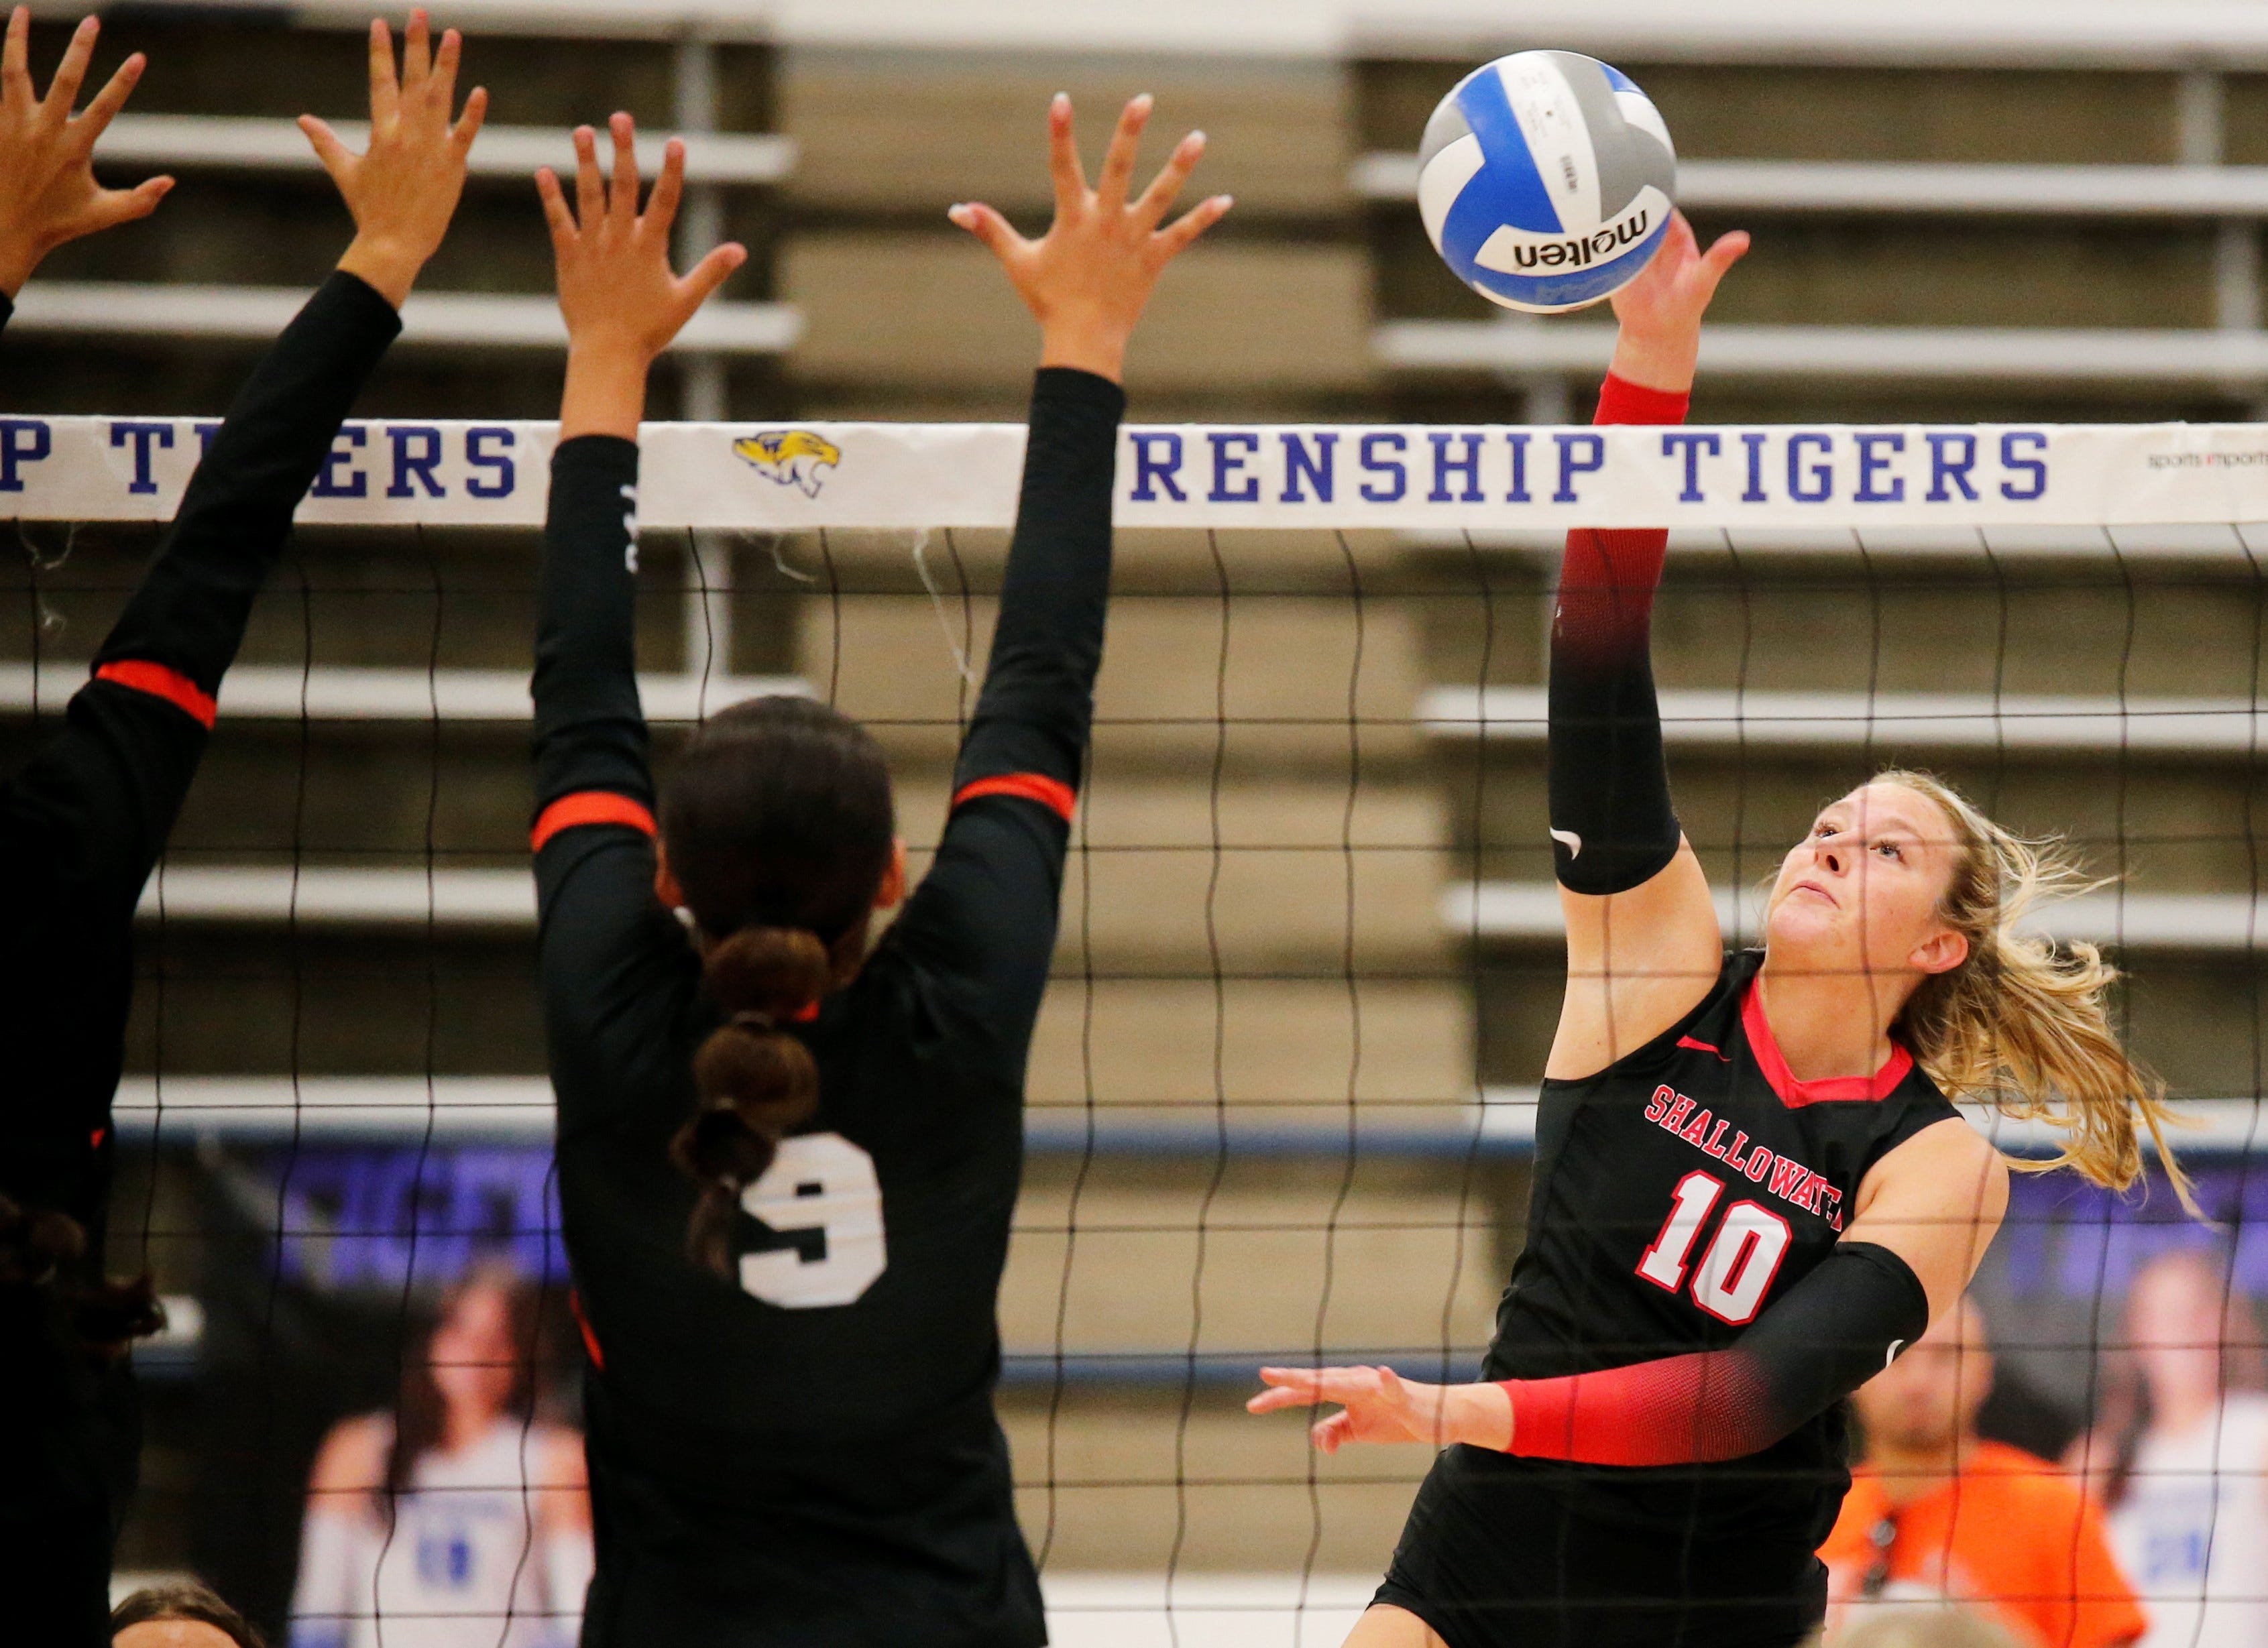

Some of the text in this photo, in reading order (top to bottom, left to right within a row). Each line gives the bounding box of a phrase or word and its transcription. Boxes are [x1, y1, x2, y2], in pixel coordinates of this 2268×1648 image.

[1514, 210, 1648, 267] molten
[111, 423, 515, 497] TERS
[1662, 431, 2047, 503] TIGERS
[2148, 453, 2202, 470] sports
[739, 1131, 888, 1308] 9
[1635, 1169, 1793, 1326] 10
